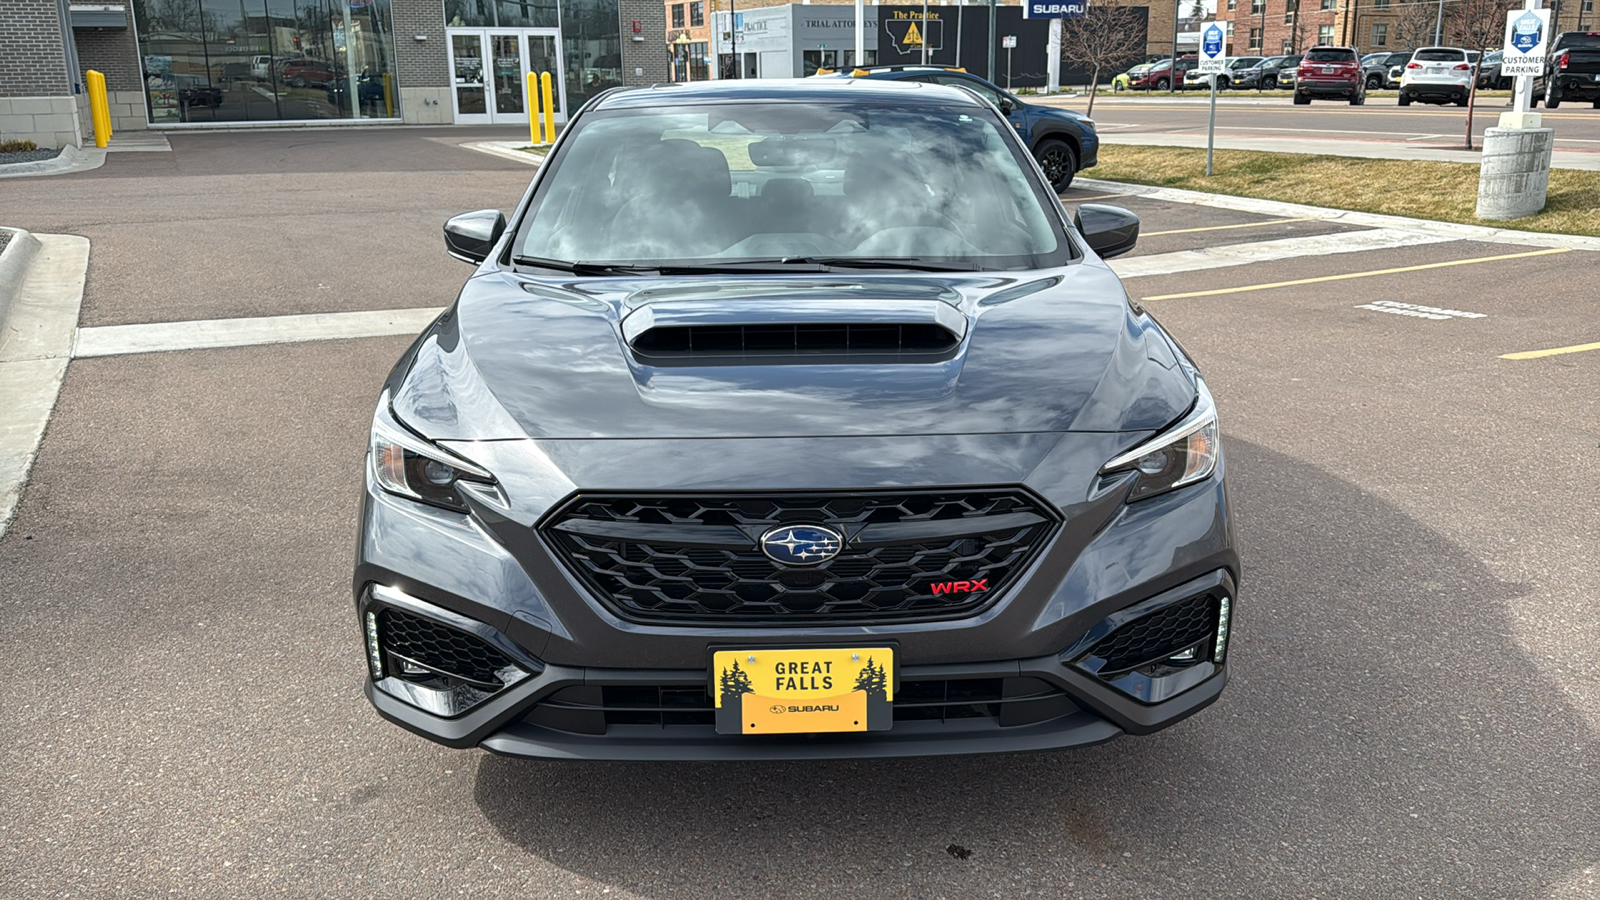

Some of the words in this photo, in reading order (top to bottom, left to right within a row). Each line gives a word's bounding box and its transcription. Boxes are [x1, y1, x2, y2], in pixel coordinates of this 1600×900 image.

[1033, 4, 1084, 14] SUBARU
[893, 10, 908, 19] The
[909, 10, 940, 19] Pratice
[744, 20, 768, 32] PRACTICE
[805, 20, 831, 28] TRIAL
[832, 20, 878, 28] ATTOEYS
[1502, 56, 1545, 64] CUSTOMER
[930, 578, 988, 595] WRX
[775, 661, 833, 675] GREAT
[775, 676, 833, 691] FALLS
[788, 704, 840, 713] SUBARU
